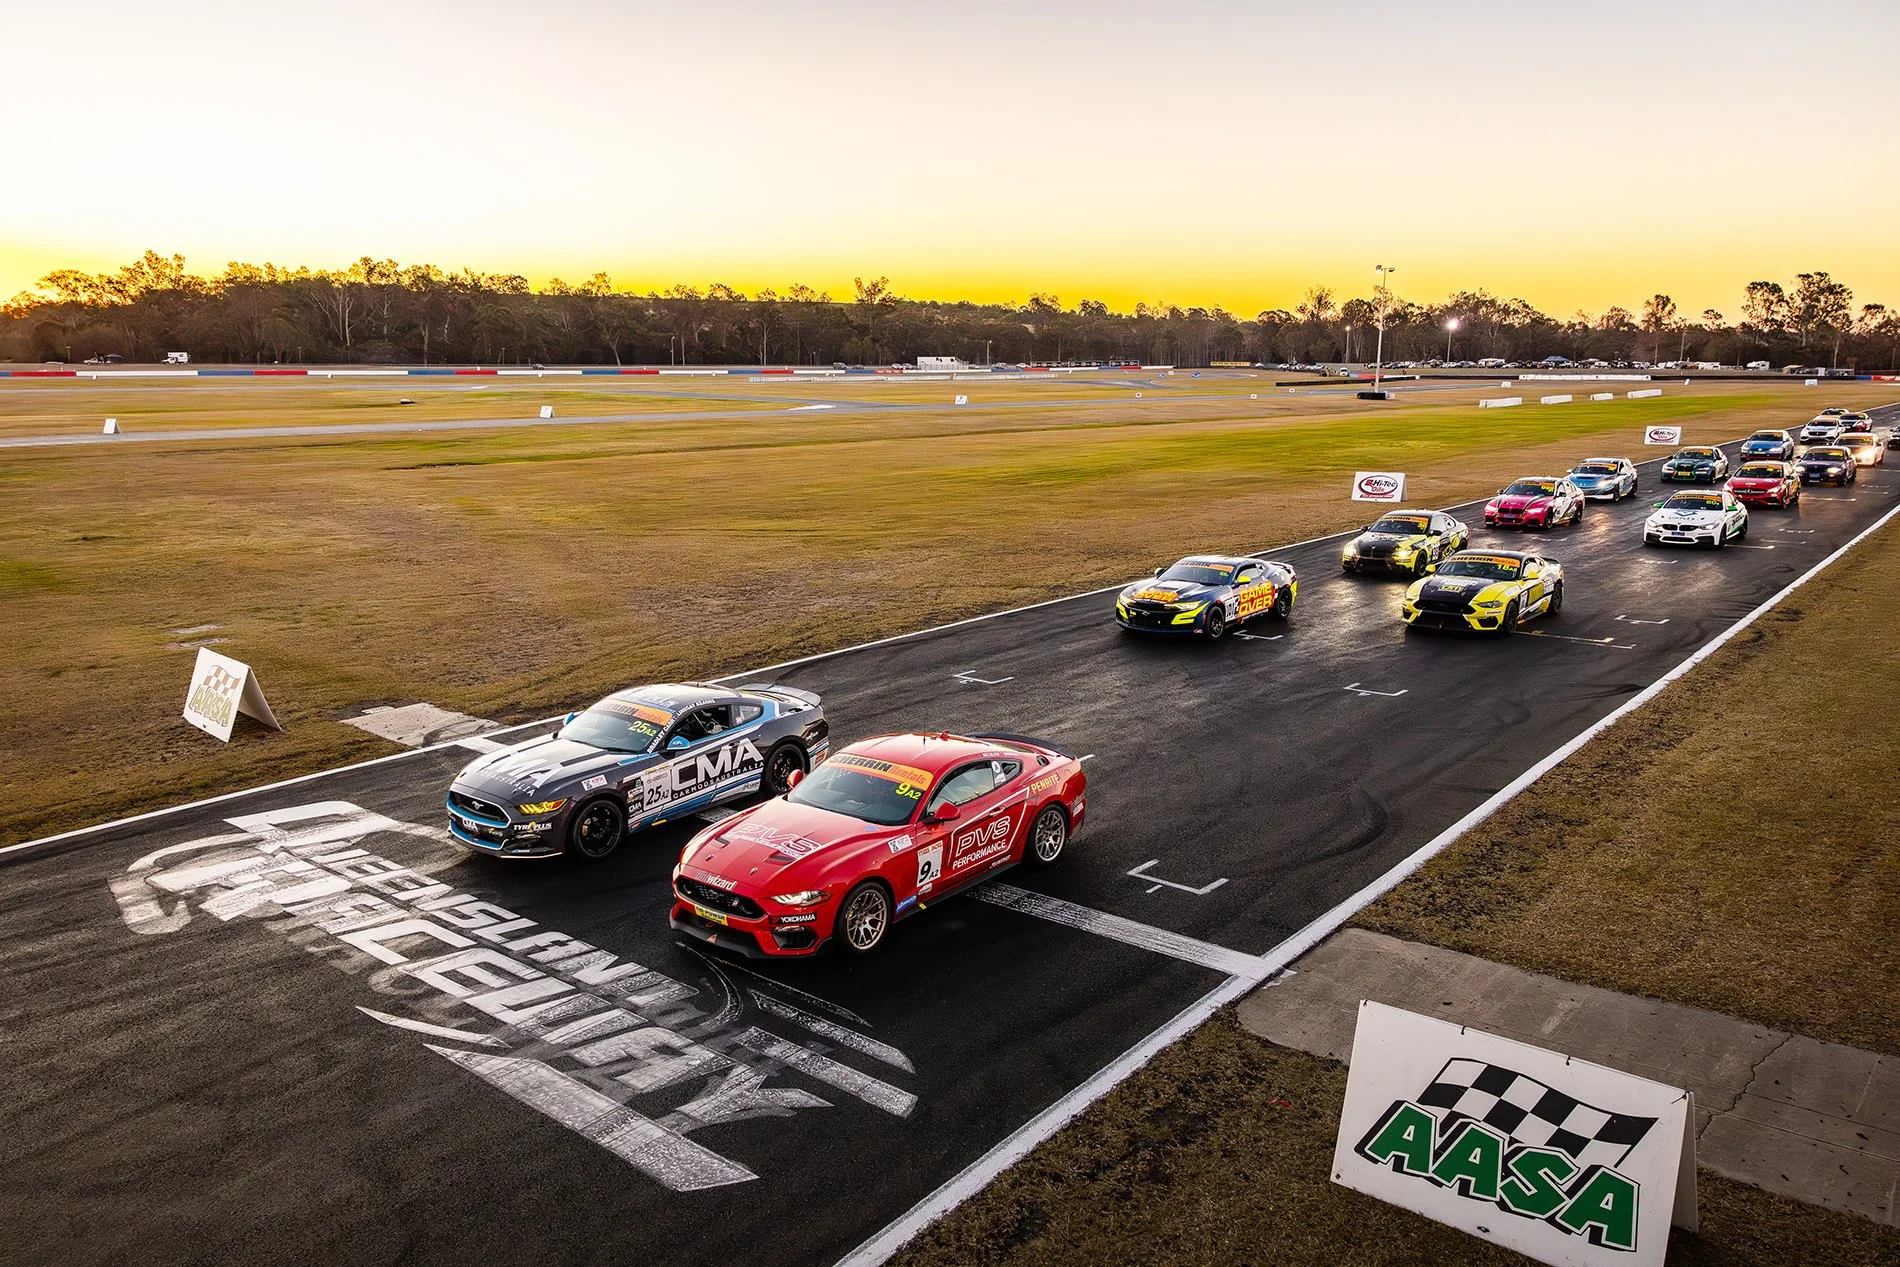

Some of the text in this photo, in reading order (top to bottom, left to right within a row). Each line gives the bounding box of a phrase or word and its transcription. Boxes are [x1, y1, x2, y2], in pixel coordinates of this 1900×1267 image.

[1372, 479, 1397, 488] Hi-Tec
[1239, 594, 1273, 616] OVER
[1240, 580, 1273, 603] GAME
[188, 683, 233, 728] AASA
[671, 737, 764, 792] CMA
[829, 755, 893, 773] SHERRIN
[888, 763, 928, 786] Rentals
[1030, 773, 1060, 794] PENRITE
[955, 815, 1011, 857] PVS
[952, 838, 1006, 870] PERFORMANCE
[780, 913, 816, 923] YOKOHAMA
[1354, 1100, 1641, 1252] AASA
